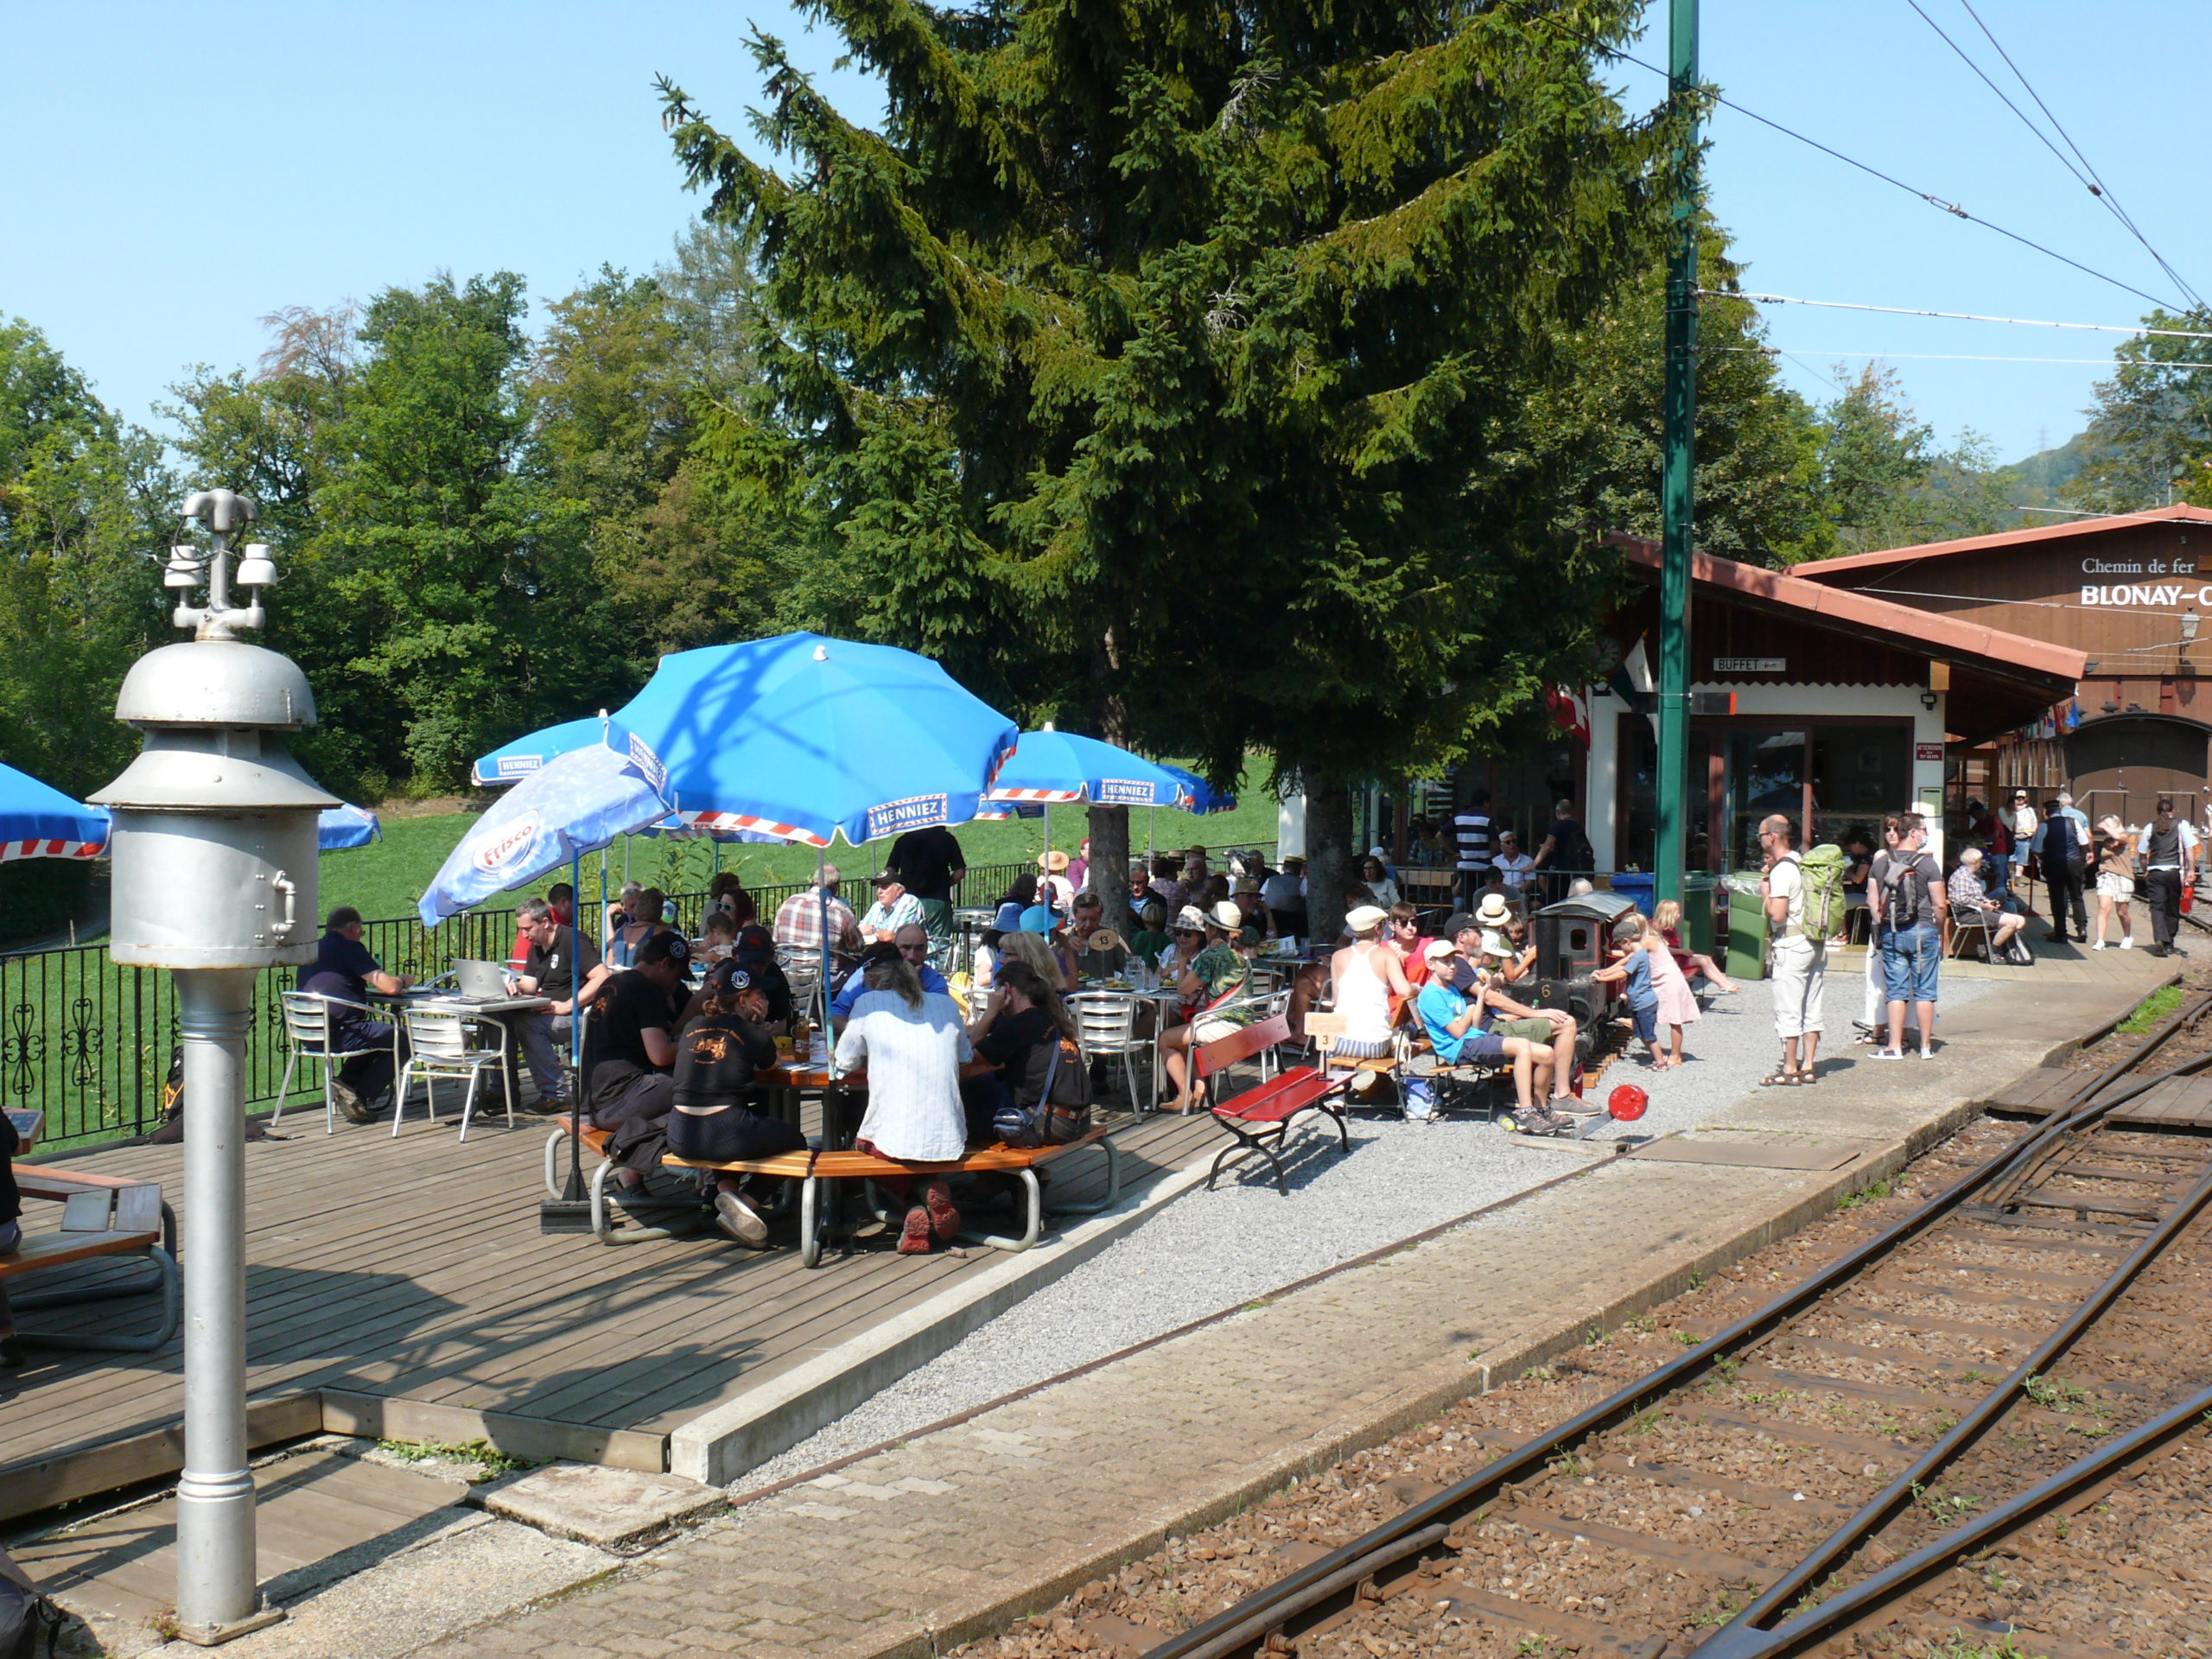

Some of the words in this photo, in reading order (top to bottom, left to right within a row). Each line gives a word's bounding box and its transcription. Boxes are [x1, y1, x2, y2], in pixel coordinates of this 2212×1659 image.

[2082, 557, 2142, 574] Chemin
[2148, 558, 2166, 574] de
[2171, 557, 2195, 574] fer
[1718, 658, 1759, 671] BUFFET
[502, 760, 538, 771] HENNIEZ
[1107, 784, 1148, 797] HENNIEZ
[877, 802, 938, 826] HENNIEZ
[484, 824, 532, 866] Frisco
[1099, 935, 1109, 945] 13
[1541, 984, 1551, 998] 6
[1322, 1035, 1329, 1046] 3
